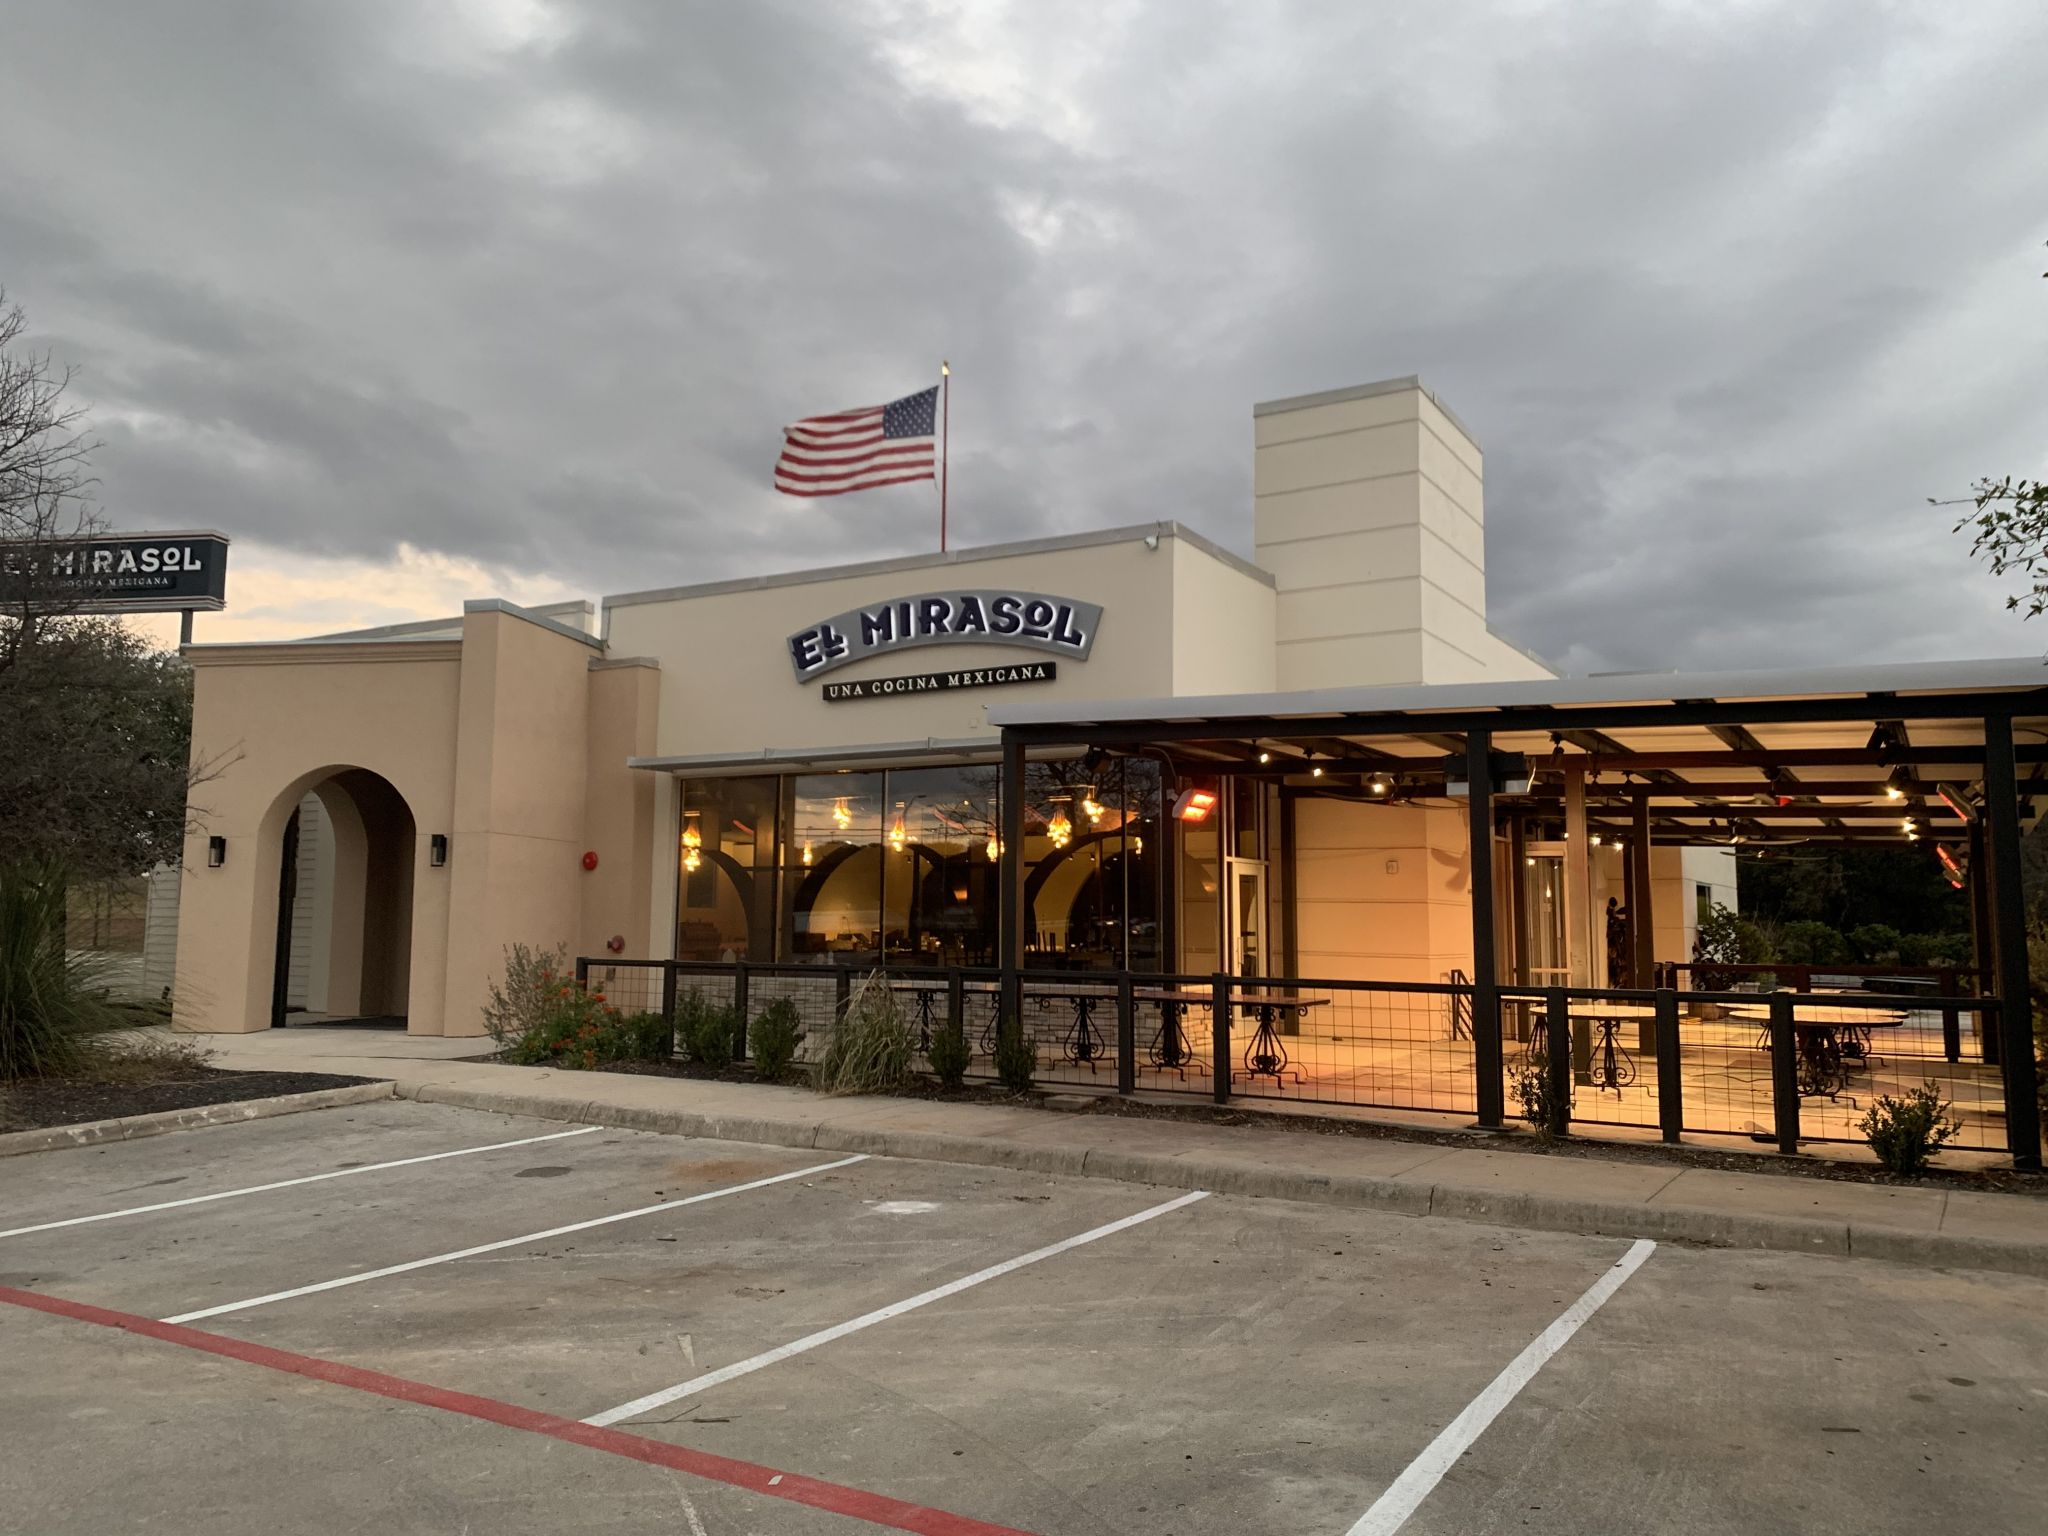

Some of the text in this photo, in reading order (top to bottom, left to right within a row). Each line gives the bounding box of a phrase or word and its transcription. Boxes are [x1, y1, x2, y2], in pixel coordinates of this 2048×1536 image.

[52, 547, 201, 576] MIRASOL
[108, 577, 169, 587] MEXICANA
[792, 596, 1087, 670] EL MIRASOL
[829, 665, 1046, 698] UNA COCINA MEXICANA
